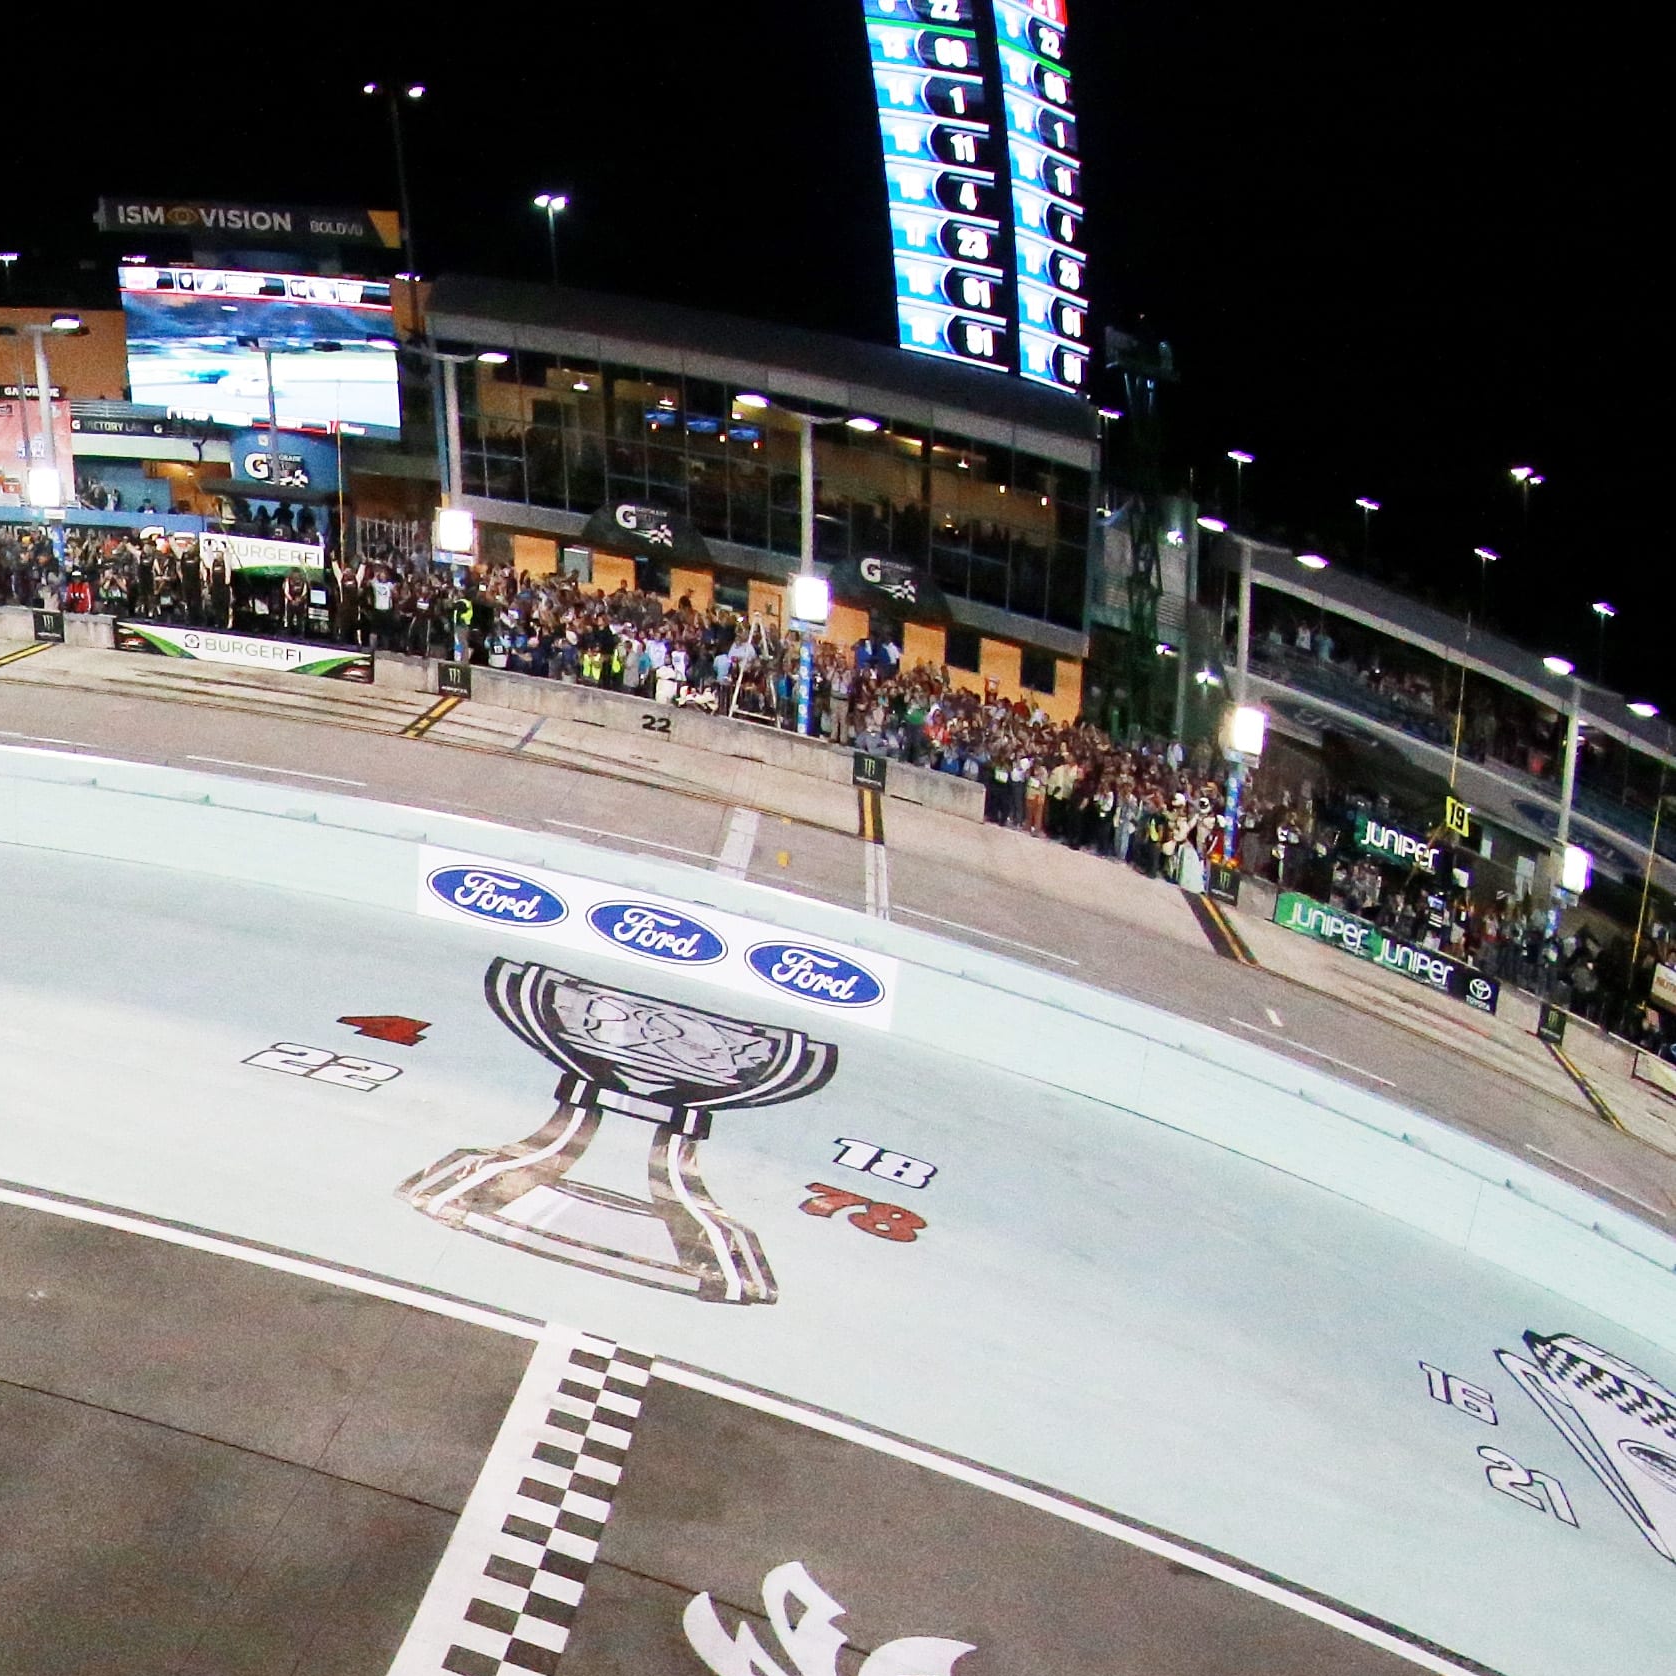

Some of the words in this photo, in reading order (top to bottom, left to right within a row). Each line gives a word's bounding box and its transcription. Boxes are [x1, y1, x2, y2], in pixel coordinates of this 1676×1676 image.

[951, 134, 976, 162] 11
[118, 205, 165, 225] ISM
[199, 208, 292, 232] VISION
[4, 387, 59, 397] GAORE
[231, 542, 321, 566] URGERFI
[203, 637, 303, 664] BURGERFI
[641, 714, 672, 734] 22
[1449, 799, 1465, 831] 19
[453, 871, 542, 922] Ford
[612, 908, 702, 960] Ford
[770, 948, 859, 1002] Ford
[1465, 995, 1492, 1011] TOYOTA
[336, 1015, 432, 1045] 4
[239, 1042, 403, 1092] 22
[833, 1136, 939, 1189] 18
[798, 1182, 929, 1242] 78
[1418, 1360, 1498, 1426] 16
